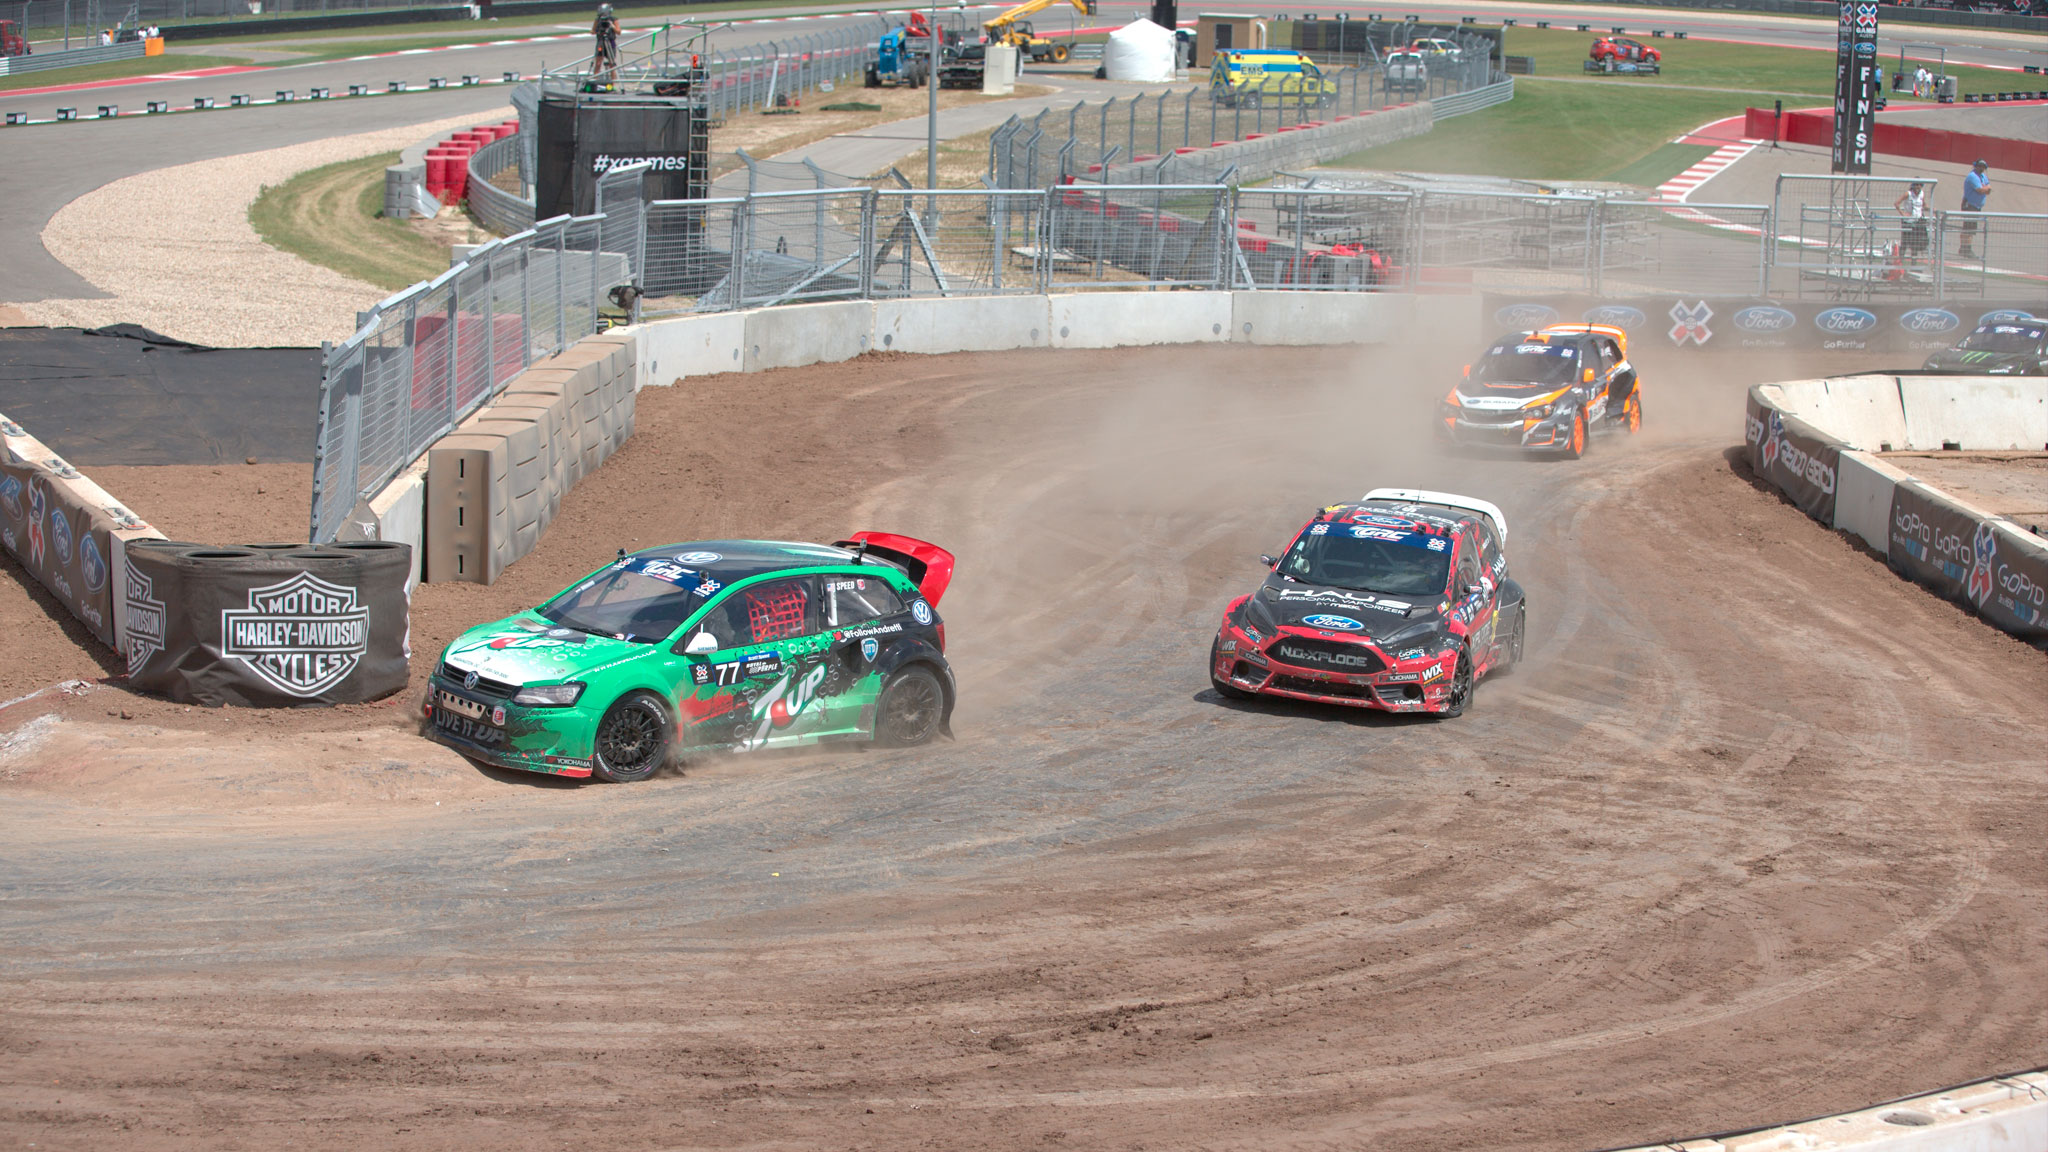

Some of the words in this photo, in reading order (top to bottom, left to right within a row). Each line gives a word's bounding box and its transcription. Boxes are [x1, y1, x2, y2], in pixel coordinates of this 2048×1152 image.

[1240, 66, 1264, 76] EMS
[1854, 66, 1871, 165] FINISH
[593, 154, 687, 173] #xmes
[1744, 309, 1784, 329] Ford
[1827, 311, 1865, 330] Ford
[1911, 311, 1948, 330] Ford
[1823, 340, 1836, 349] Go
[1836, 340, 1867, 349] Further
[1895, 505, 1930, 543] GoPro
[1934, 527, 1971, 564] GoPro
[836, 581, 855, 591] SPEED
[1998, 563, 2045, 606] GoPro
[268, 587, 341, 613] MOTOR
[1341, 599, 1406, 616] VAPORIZER
[1314, 615, 1353, 629] Ford
[236, 620, 363, 646] HARLEY-DAVIDSON
[1399, 648, 1425, 658] GoPro
[265, 653, 342, 687] CYCLES
[715, 661, 741, 687] 77
[1422, 661, 1444, 681] WIX
[642, 699, 666, 725] ADVAN
[435, 707, 460, 732] LIVE
[462, 717, 474, 737] IT
[475, 724, 505, 743] UP
[557, 758, 591, 768] YOKOHAMA
